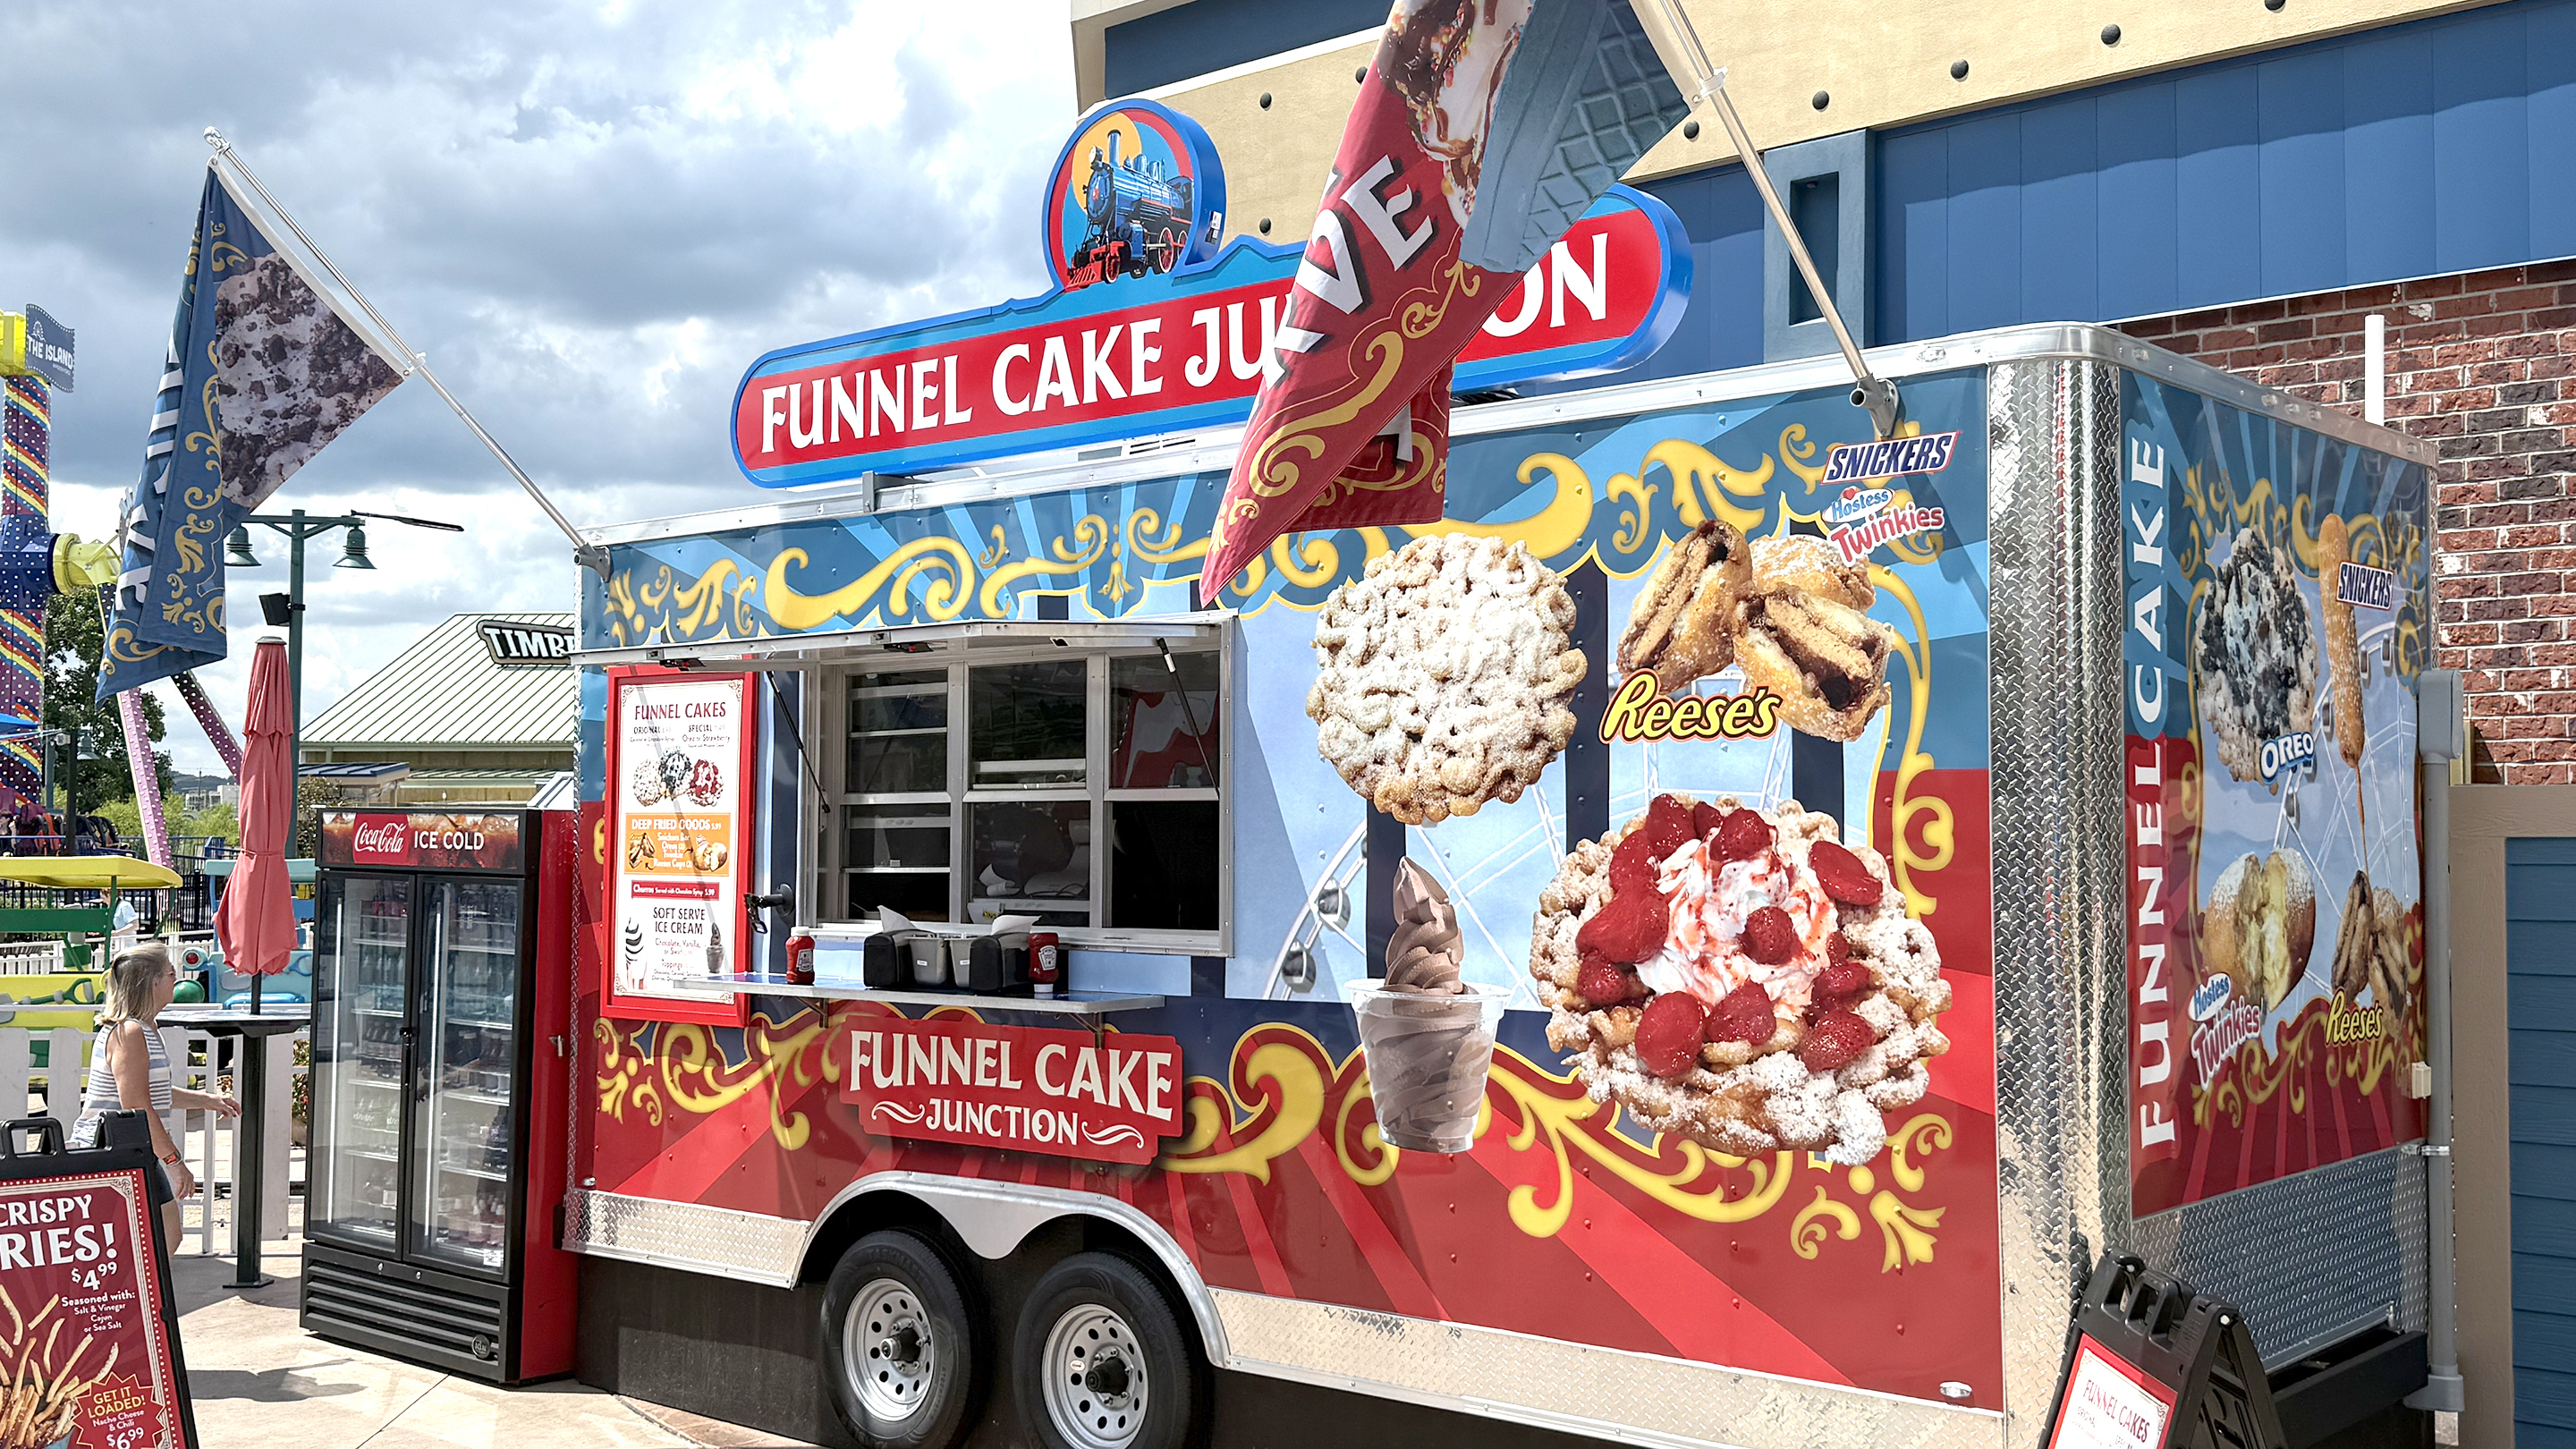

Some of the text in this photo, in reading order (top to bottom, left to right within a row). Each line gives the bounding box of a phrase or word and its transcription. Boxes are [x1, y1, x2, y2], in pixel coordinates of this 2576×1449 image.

[27, 335, 44, 359] THE
[46, 343, 73, 370] ISLAND
[760, 354, 973, 453] FUNNEL
[991, 318, 1163, 416] CAKE
[1826, 434, 1953, 481] SNICKERS
[1831, 488, 1890, 523] Hostess
[1831, 507, 1944, 564] Twinkies
[2338, 564, 2393, 609] SNICKERS
[635, 701, 726, 721] FUNNEL CAKES
[1602, 673, 1782, 741] Reese's
[2260, 732, 2315, 780] OREO
[2131, 436, 2176, 1149] FUNNEL CAKE
[354, 821, 407, 853] Coca-Cola
[414, 830, 485, 851] ICE COLD
[631, 818, 652, 830] DEEP
[654, 818, 677, 830] FRIED
[679, 819, 711, 831] GOODS
[653, 907, 706, 920] SOFT SERVE
[655, 921, 703, 935] ICE CREAM
[2193, 973, 2230, 1013] Hostess
[2326, 988, 2384, 1046] Reese's
[2191, 1000, 2261, 1087] Twinkies
[849, 1030, 1174, 1122] FUNNEL CAKE
[925, 1097, 1080, 1147] JUNCTION
[61, 1289, 136, 1308] Seasoned with:
[74, 1303, 126, 1315] Salt & Vinegar
[90, 1314, 113, 1324] Cajun
[93, 1324, 106, 1332] Sea
[107, 1321, 123, 1329] Salt
[88, 1394, 146, 1419] LOADED!
[93, 1386, 131, 1404] GET IT
[2083, 1379, 2118, 1419] FUNNEL
[2118, 1405, 2150, 1443] CAKES
[92, 1411, 145, 1427] Nacho Cheese
[116, 1419, 135, 1429] Chili
